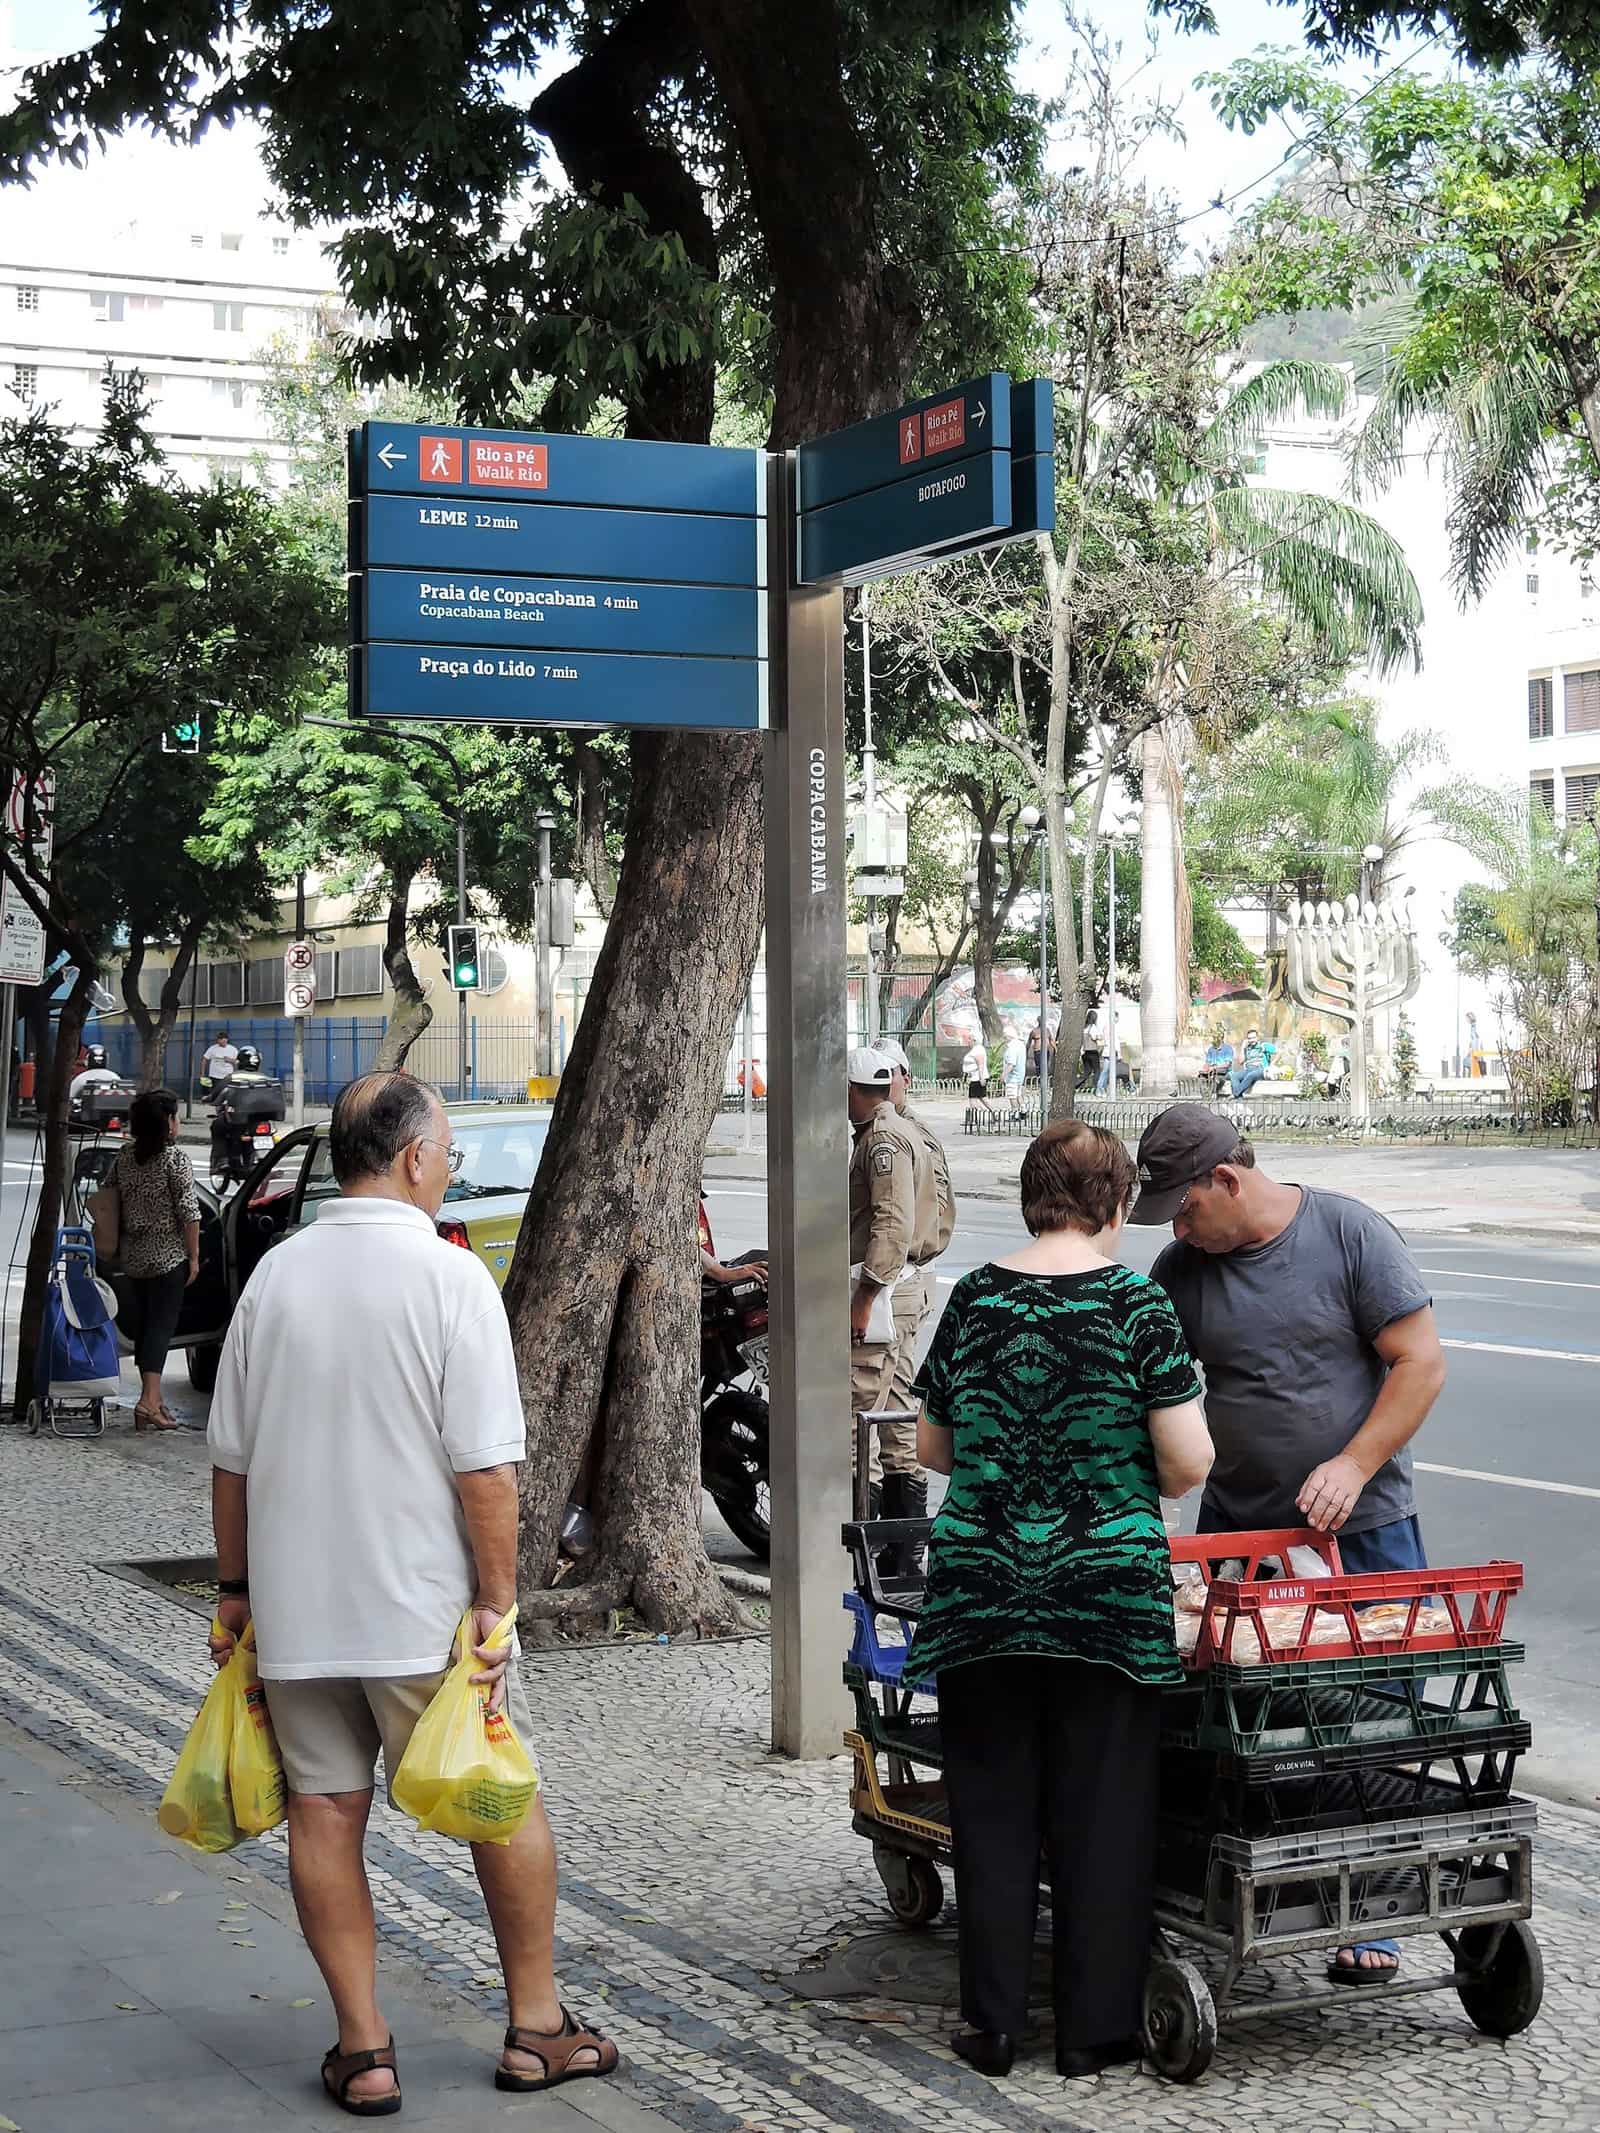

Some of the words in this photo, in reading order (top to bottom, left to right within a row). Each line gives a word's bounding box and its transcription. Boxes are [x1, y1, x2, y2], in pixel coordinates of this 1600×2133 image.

[928, 414, 940, 430] Rio
[940, 415, 946, 425] a
[948, 405, 958, 422] Pé
[928, 430, 947, 448] Walk
[949, 425, 962, 441] Rio
[476, 448, 500, 462] Rio
[504, 454, 514, 462] a
[516, 450, 534, 464] Pé
[476, 464, 514, 480] Walk
[518, 468, 542, 482] Rio
[918, 473, 966, 502] BOTAFOGO
[419, 509, 468, 526] LEME
[419, 584, 465, 601] Praia
[469, 586, 490, 602] de
[494, 588, 596, 607] Copacabana
[420, 604, 500, 620] Copacabana
[504, 607, 544, 622] Beach
[419, 657, 469, 678] Praça
[473, 660, 494, 676] do
[498, 660, 536, 677] Lido
[810, 747, 827, 895] COPACABANA
[1267, 1586, 1305, 1600] ALWAYS
[1274, 1762, 1299, 1772] GOLDEN
[1300, 1759, 1316, 1768] VITAL
